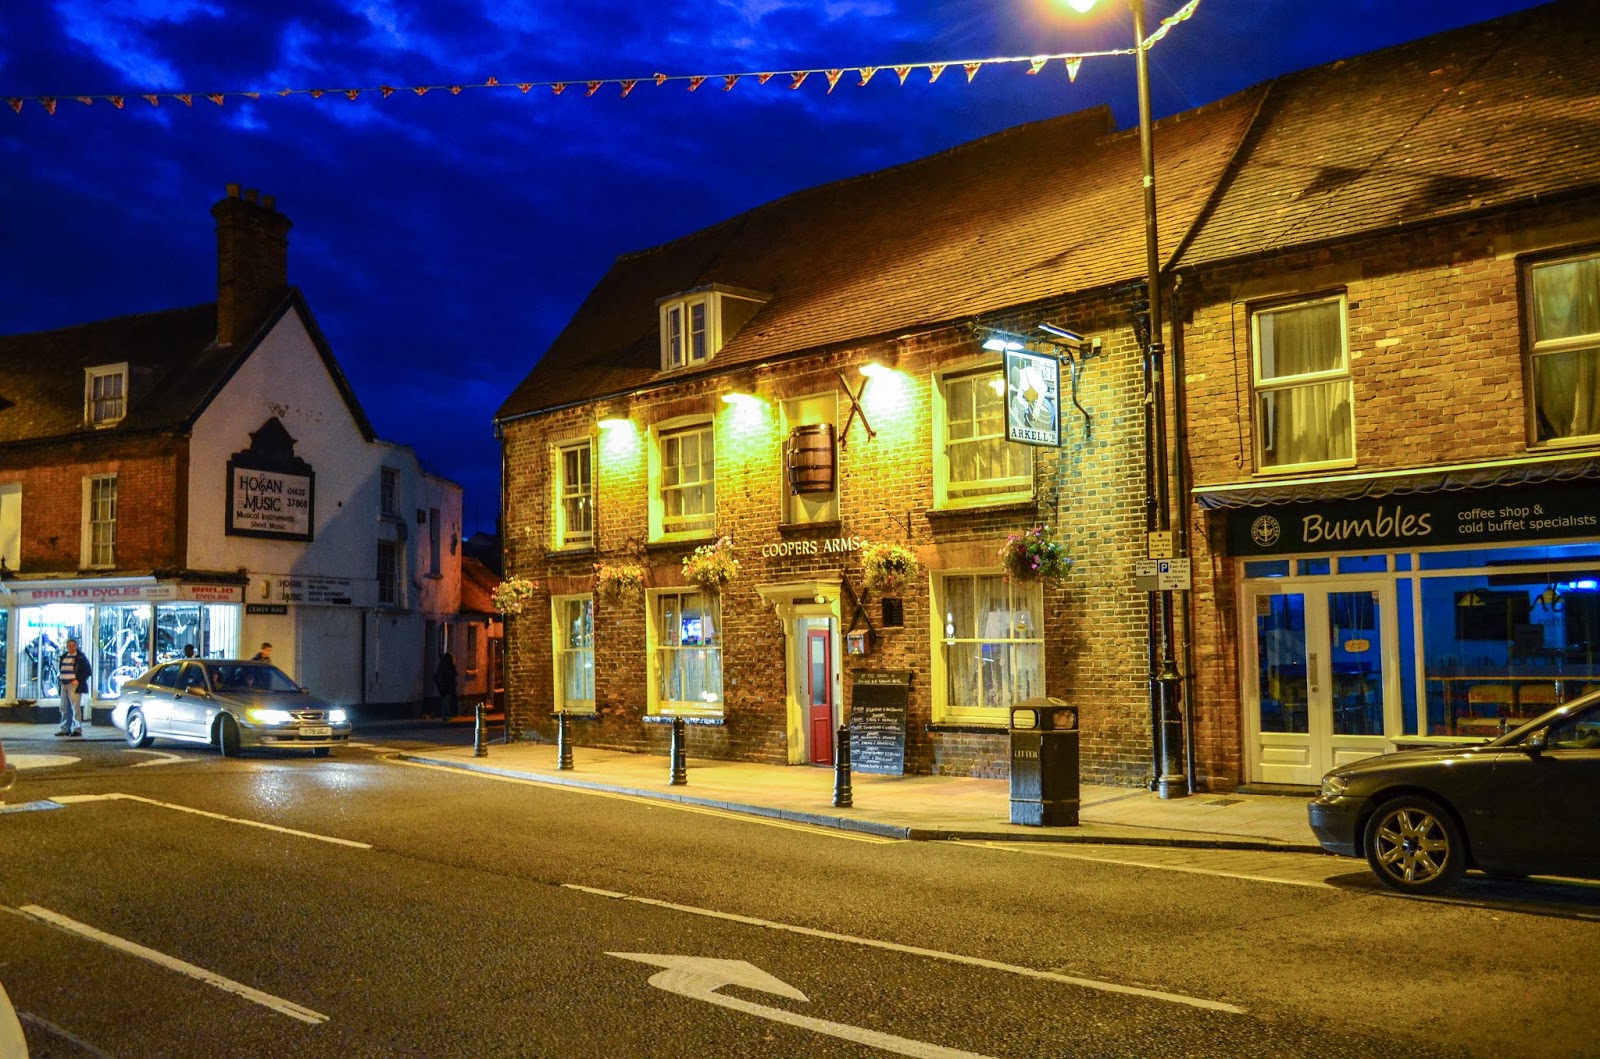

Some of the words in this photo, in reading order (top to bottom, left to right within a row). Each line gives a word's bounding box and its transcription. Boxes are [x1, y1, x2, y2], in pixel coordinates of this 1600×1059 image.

[1011, 427, 1056, 442] ARKELL'S
[240, 474, 282, 494] HOGAN
[243, 496, 281, 511] MUSIC
[1457, 508, 1495, 520] coffee
[1499, 506, 1529, 518] shop
[1533, 504, 1544, 515] &
[1302, 505, 1432, 543] Bumbles
[1458, 522, 1483, 534] cold
[1488, 520, 1525, 532] buffet
[1529, 515, 1597, 531] specialists
[762, 541, 818, 558] COOPERS
[823, 537, 860, 553] ARMS
[1161, 563, 1168, 572] P
[92, 587, 141, 596] CYCLES
[1014, 750, 1038, 759] LITTER
